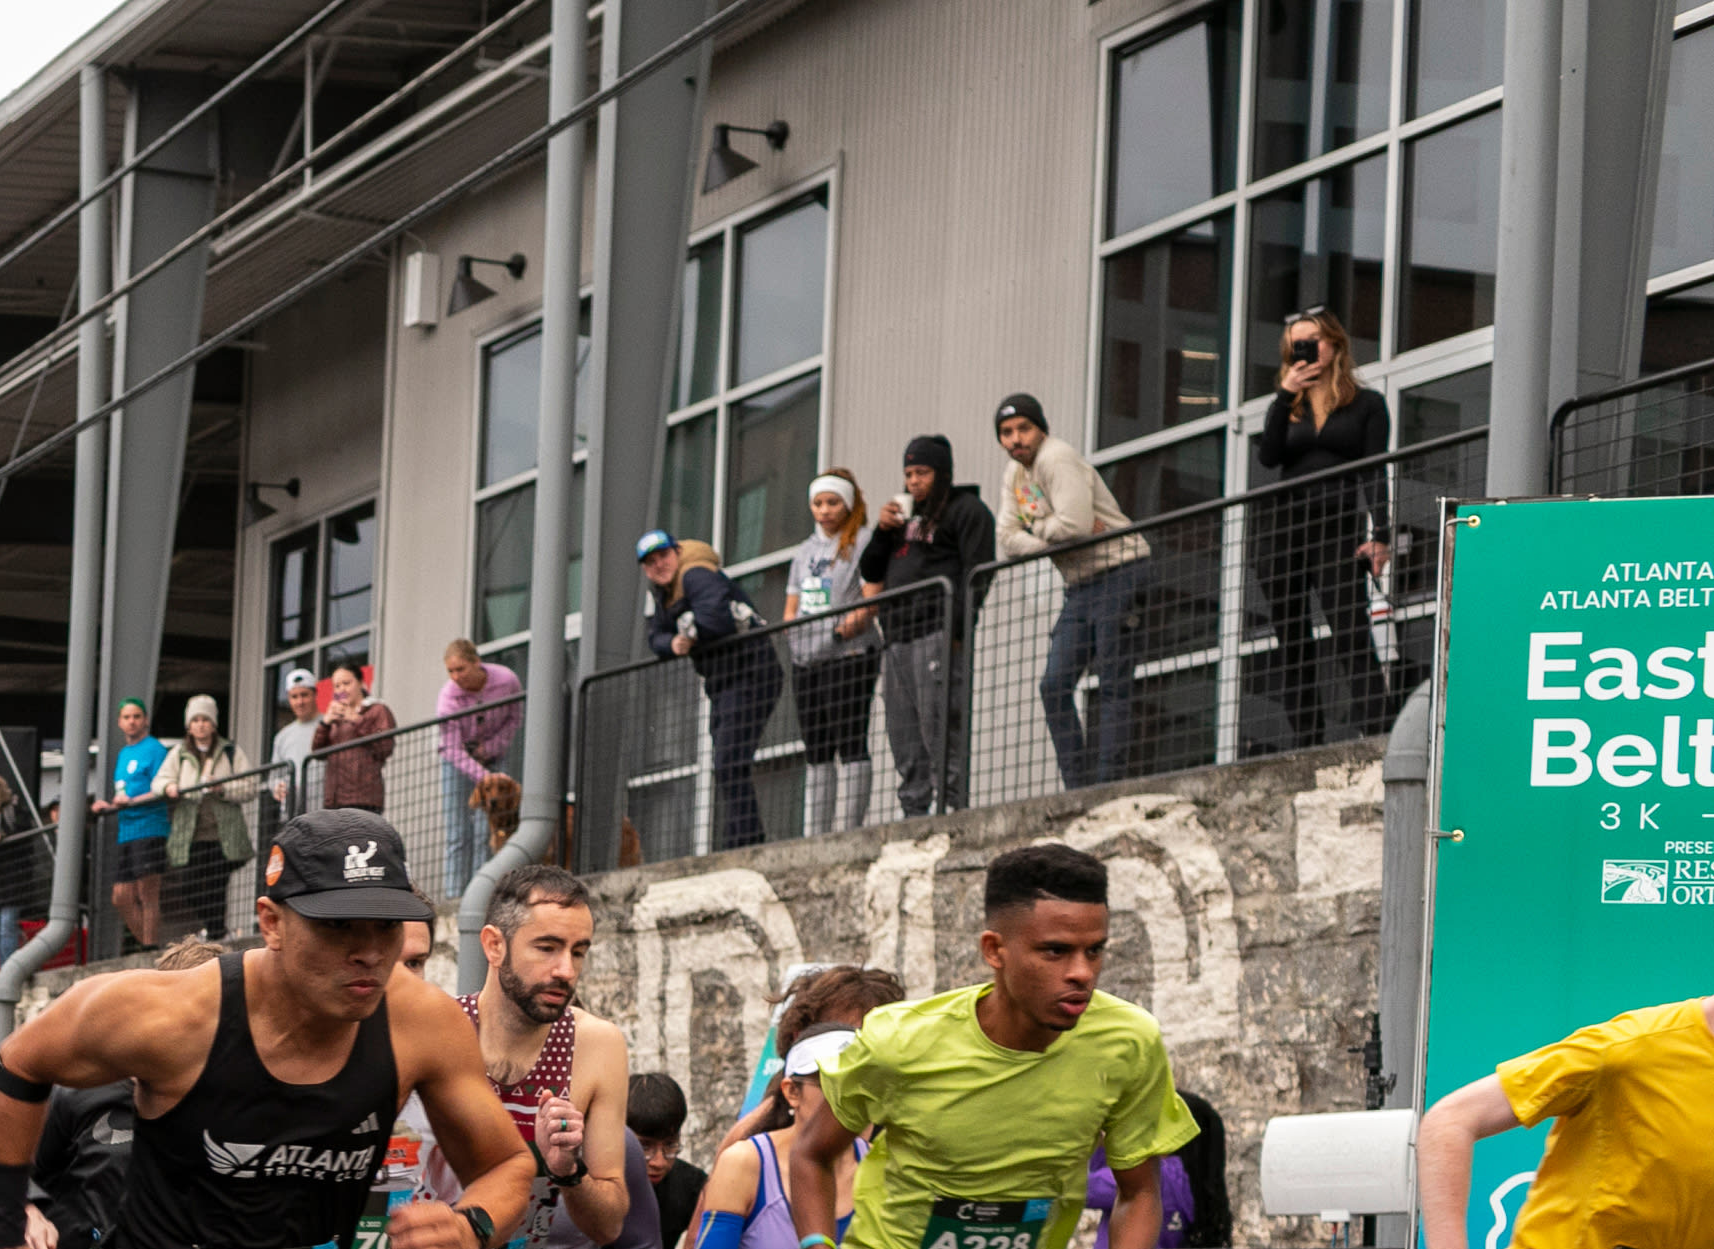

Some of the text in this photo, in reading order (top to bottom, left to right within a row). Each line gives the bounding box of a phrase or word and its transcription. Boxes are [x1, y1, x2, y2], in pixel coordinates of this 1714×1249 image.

[1601, 561, 1714, 582] ATLANTA
[1540, 589, 1652, 610] ATLANTA
[1673, 860, 1714, 880] RE
[264, 1144, 377, 1172] ATLANTA
[264, 1166, 325, 1181] TRACK
